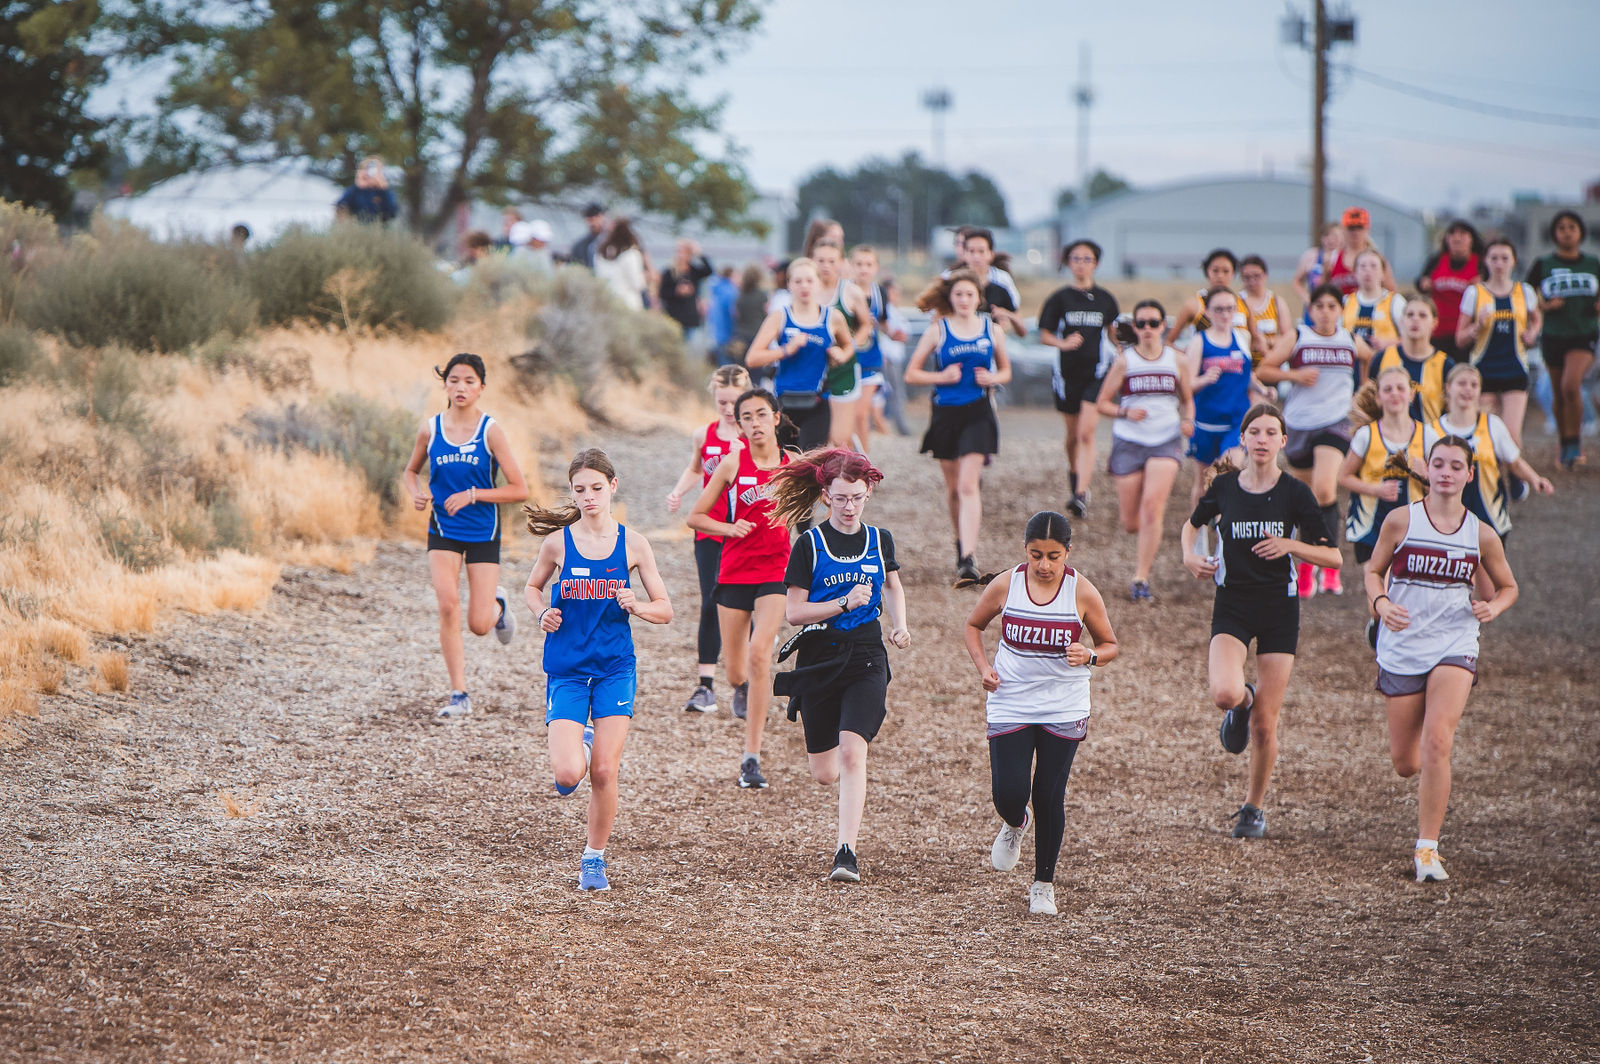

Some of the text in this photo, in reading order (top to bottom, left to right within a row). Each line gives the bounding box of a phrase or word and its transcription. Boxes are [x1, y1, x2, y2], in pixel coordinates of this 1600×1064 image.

[436, 453, 479, 466] COUGARS
[1231, 521, 1284, 540] MUSTANGS
[1407, 554, 1474, 580] GRIZZLIES
[823, 572, 873, 587] COUGARS
[1006, 623, 1072, 647] GRIZZLIES
